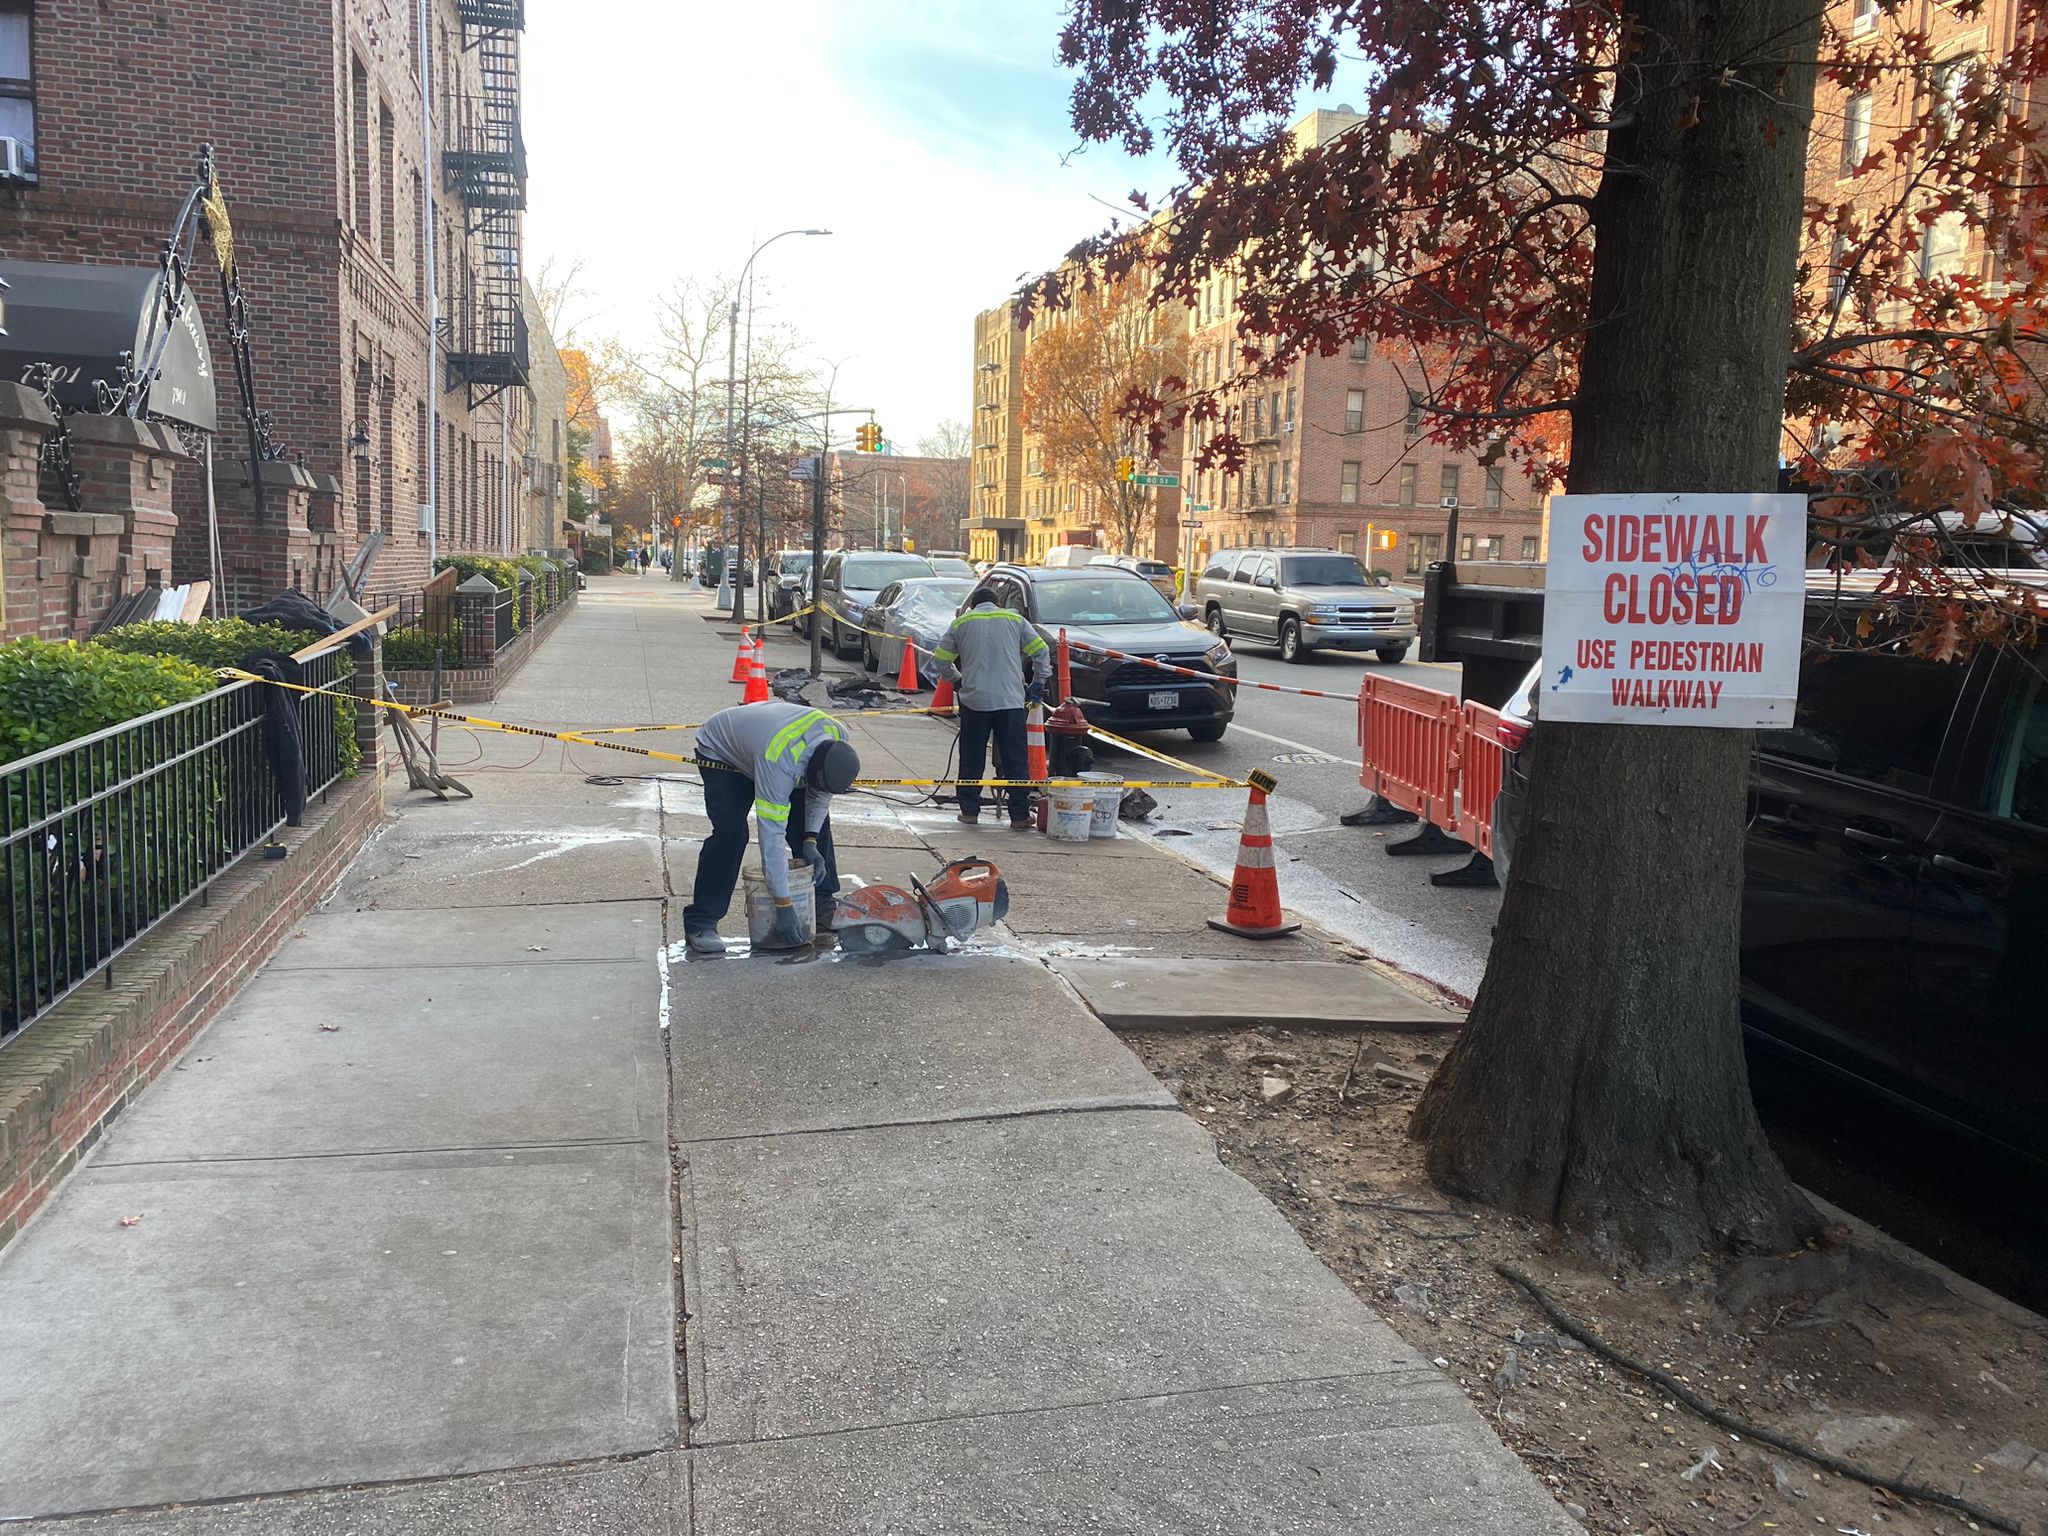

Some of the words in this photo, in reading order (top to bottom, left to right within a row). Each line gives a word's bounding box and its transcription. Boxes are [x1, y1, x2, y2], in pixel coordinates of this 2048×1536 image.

[20, 365, 80, 384] 701
[1582, 513, 1769, 564] SIDEWALK
[1603, 572, 1743, 625] CLOSED
[1577, 639, 1617, 669] USE
[1630, 640, 1764, 673] PEDESTRIAN
[1611, 678, 1723, 710] WALKWAY
